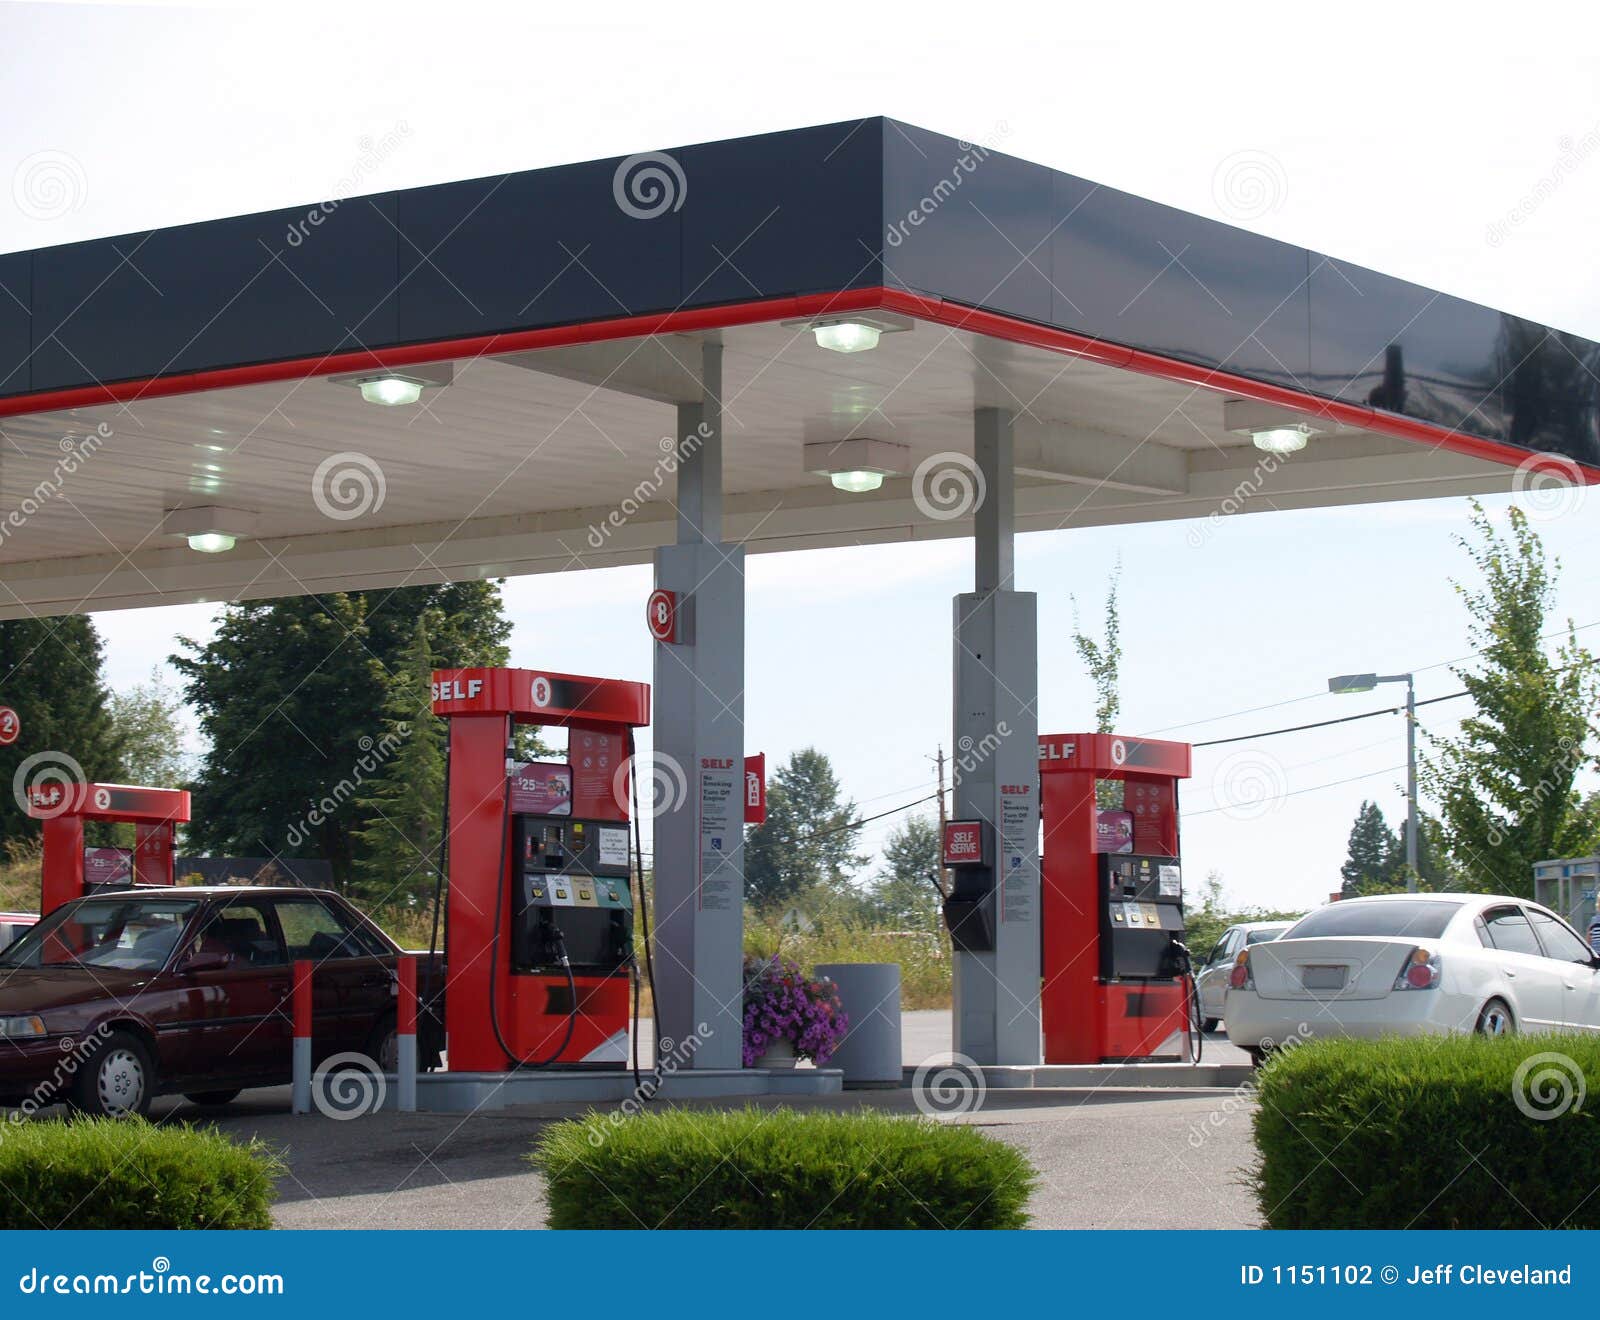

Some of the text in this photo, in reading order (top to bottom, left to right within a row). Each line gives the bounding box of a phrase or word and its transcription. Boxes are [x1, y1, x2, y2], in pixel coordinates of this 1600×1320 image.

[657, 601, 667, 624] 8
[432, 679, 482, 701] SELF
[3, 716, 13, 732] 2
[1038, 743, 1075, 760] ELF
[701, 758, 734, 769] SELF
[518, 777, 536, 791] $25
[1000, 785, 1030, 795] SELF
[954, 832, 974, 843] SELF
[950, 842, 977, 854] SERVE
